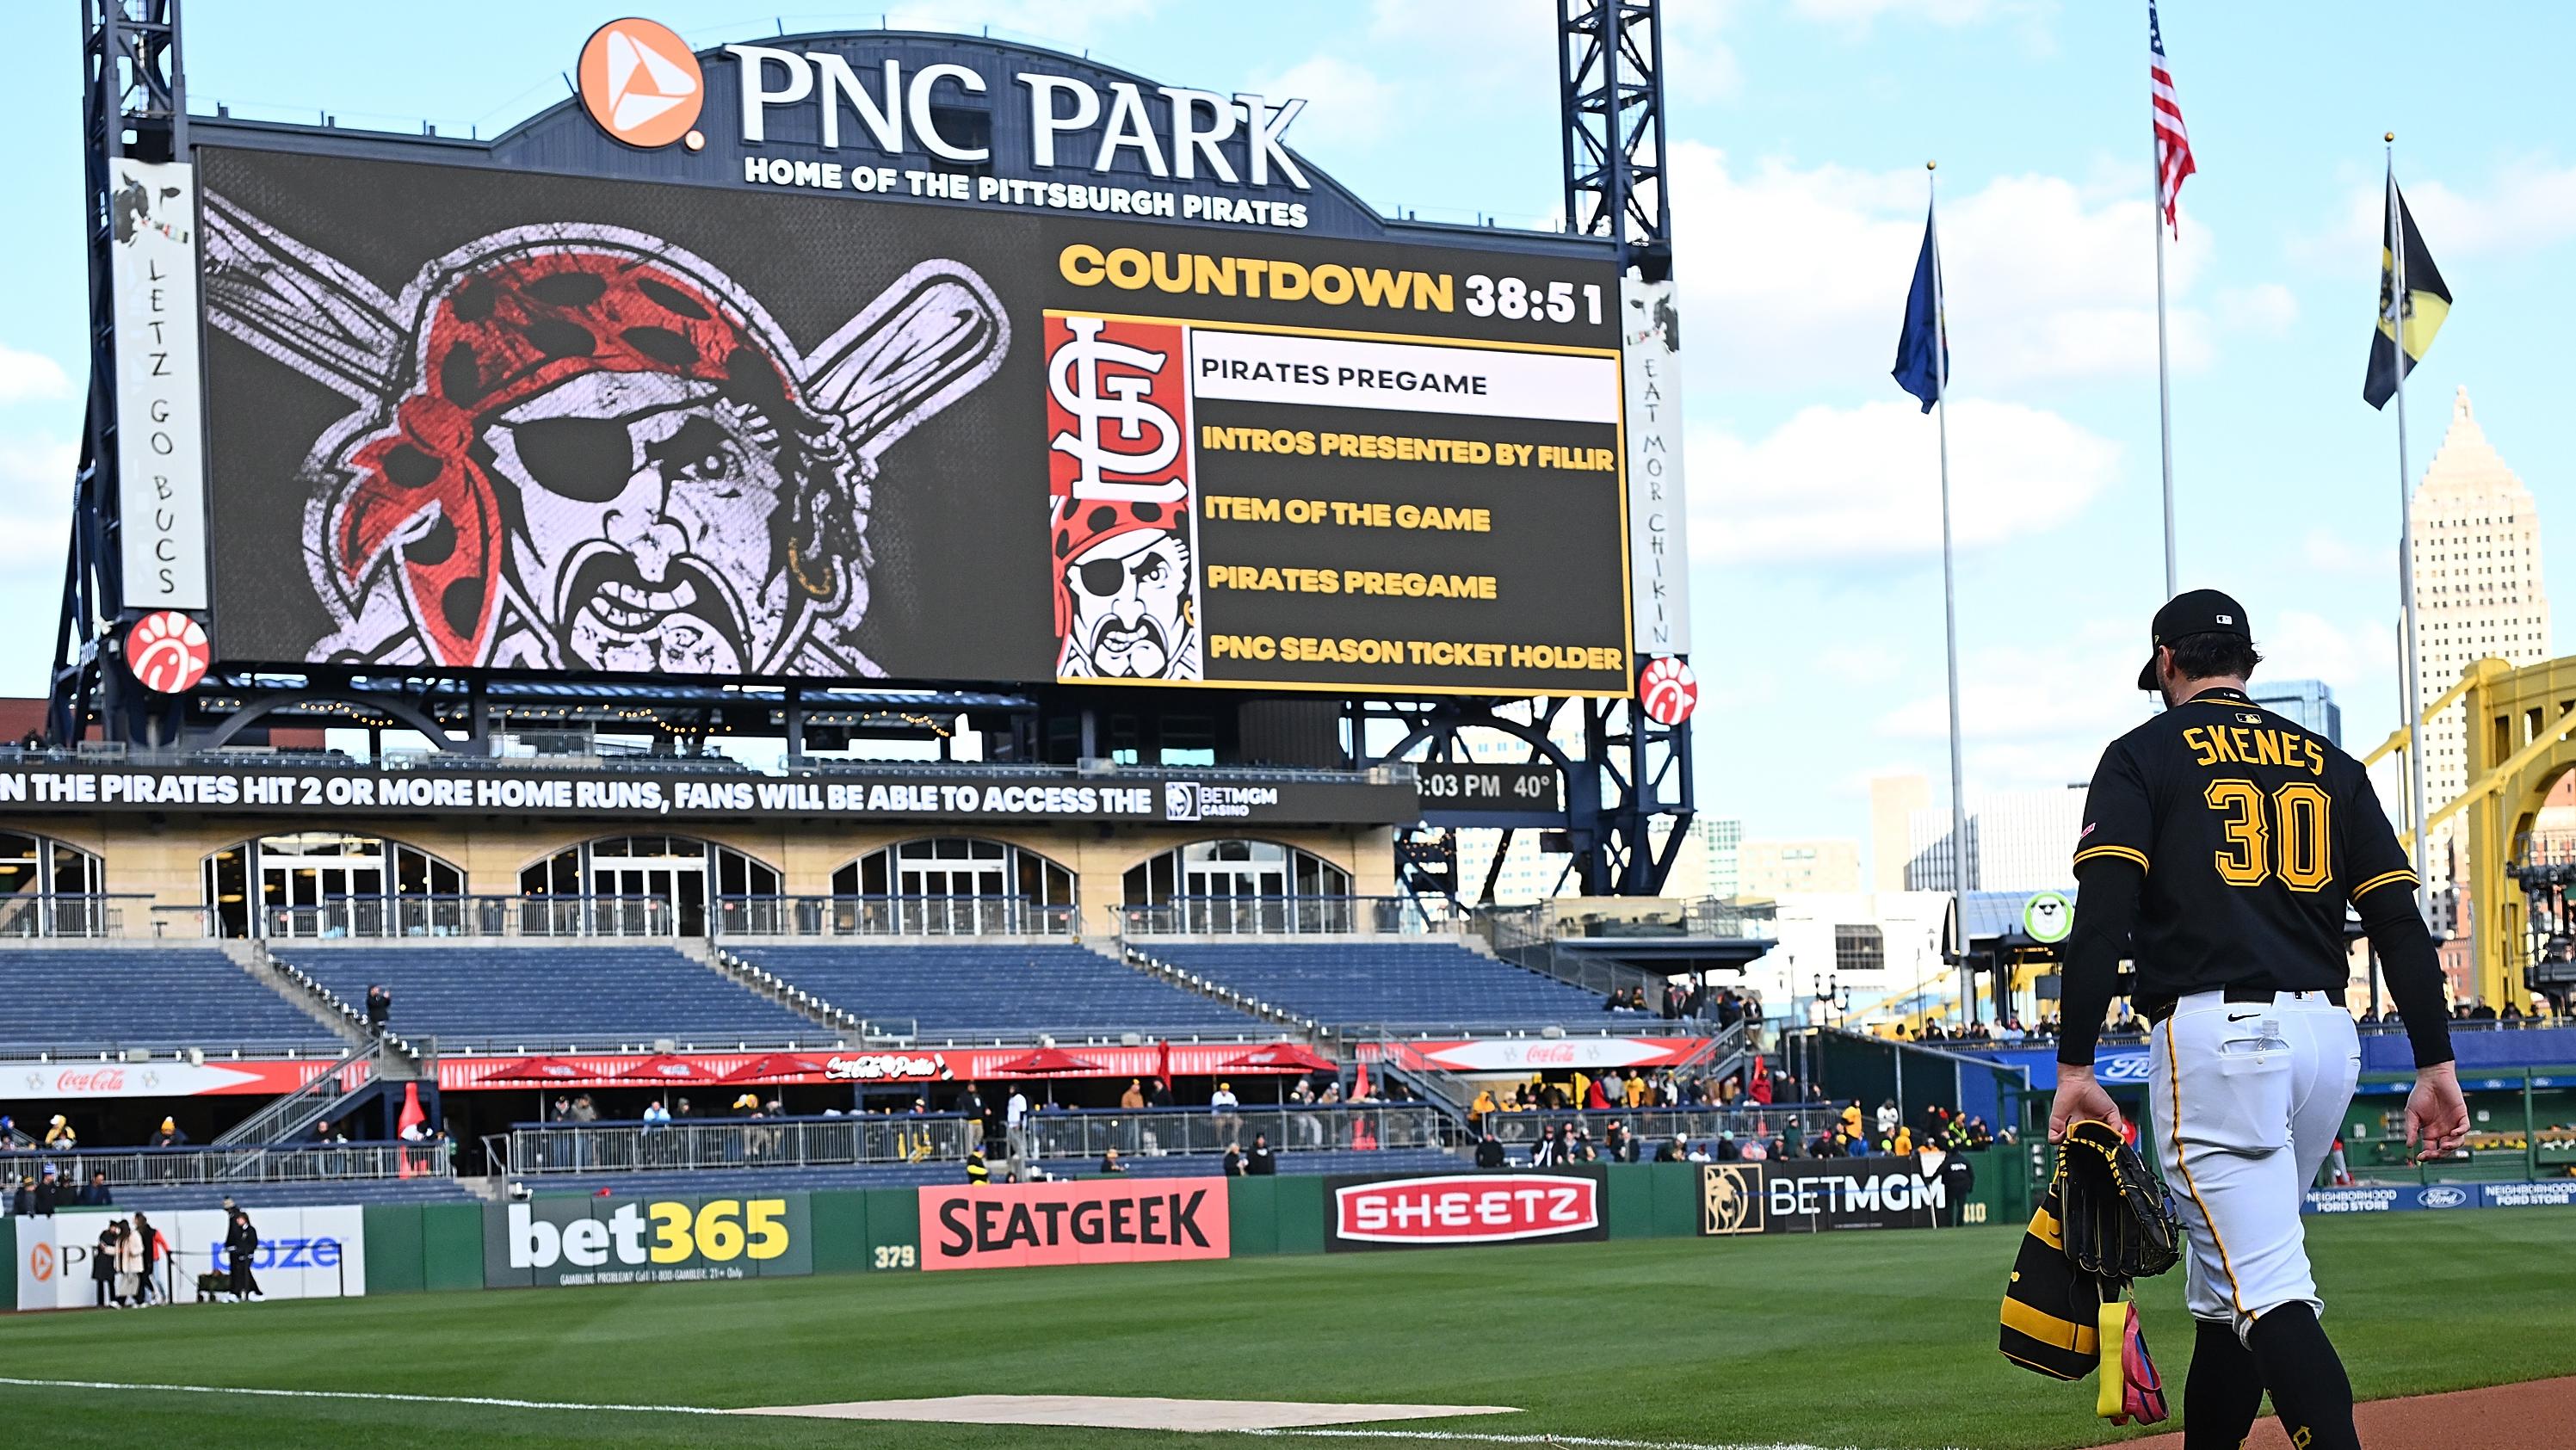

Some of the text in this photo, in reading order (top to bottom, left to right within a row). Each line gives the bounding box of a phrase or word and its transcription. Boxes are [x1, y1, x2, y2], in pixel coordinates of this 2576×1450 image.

[724, 44, 1312, 191] PNC PARK
[745, 157, 1308, 229] HOME OF THE PITTSBURGH PIRATES
[1059, 244, 1603, 325] COUNTDOWN 38:51
[1202, 357, 1488, 396] PIRATES PREGAME
[149, 258, 176, 595] LETZ GO BUCS
[1202, 425, 1615, 472] INTROS PRESENTED BY FILLIR
[1205, 495, 1491, 534] ITEM OF THE GAME
[1643, 358, 1669, 644] EAT MOR CHIKIN
[1208, 565, 1498, 600] PIRATES PREGAME
[1210, 634, 1623, 671] PNC SEASON TICKET HOLDER
[2183, 725, 2324, 776] SKENES
[30, 773, 96, 802] THE
[101, 774, 239, 805] PIRATES
[244, 776, 296, 805] HIT
[300, 776, 323, 805] 2
[326, 777, 376, 806] OR
[380, 777, 473, 807] MORE
[478, 780, 573, 809] HOME
[577, 781, 670, 815] RUNS,
[675, 781, 755, 811] FANS
[757, 783, 825, 811] WILL
[828, 784, 864, 811] BE
[868, 785, 938, 812] ABLE
[941, 785, 979, 812] TO
[982, 786, 1096, 814] ACCESS
[1100, 787, 1152, 814] THE
[1201, 787, 1278, 805] BETMGM
[1465, 774, 1501, 797] PM
[1201, 805, 1250, 817] CASINO
[2203, 778, 2334, 893] 30
[57, 1067, 125, 1093] Coca-Cola
[2104, 1055, 2150, 1077] Fo
[1356, 1188, 1579, 1230] SHEETZ
[1770, 1172, 1946, 1216] BETMGM
[508, 1198, 790, 1269] bet365
[939, 1188, 1211, 1257] SEATGEEK
[874, 1244, 917, 1268] 379
[559, 1273, 595, 1286] GAMBLING
